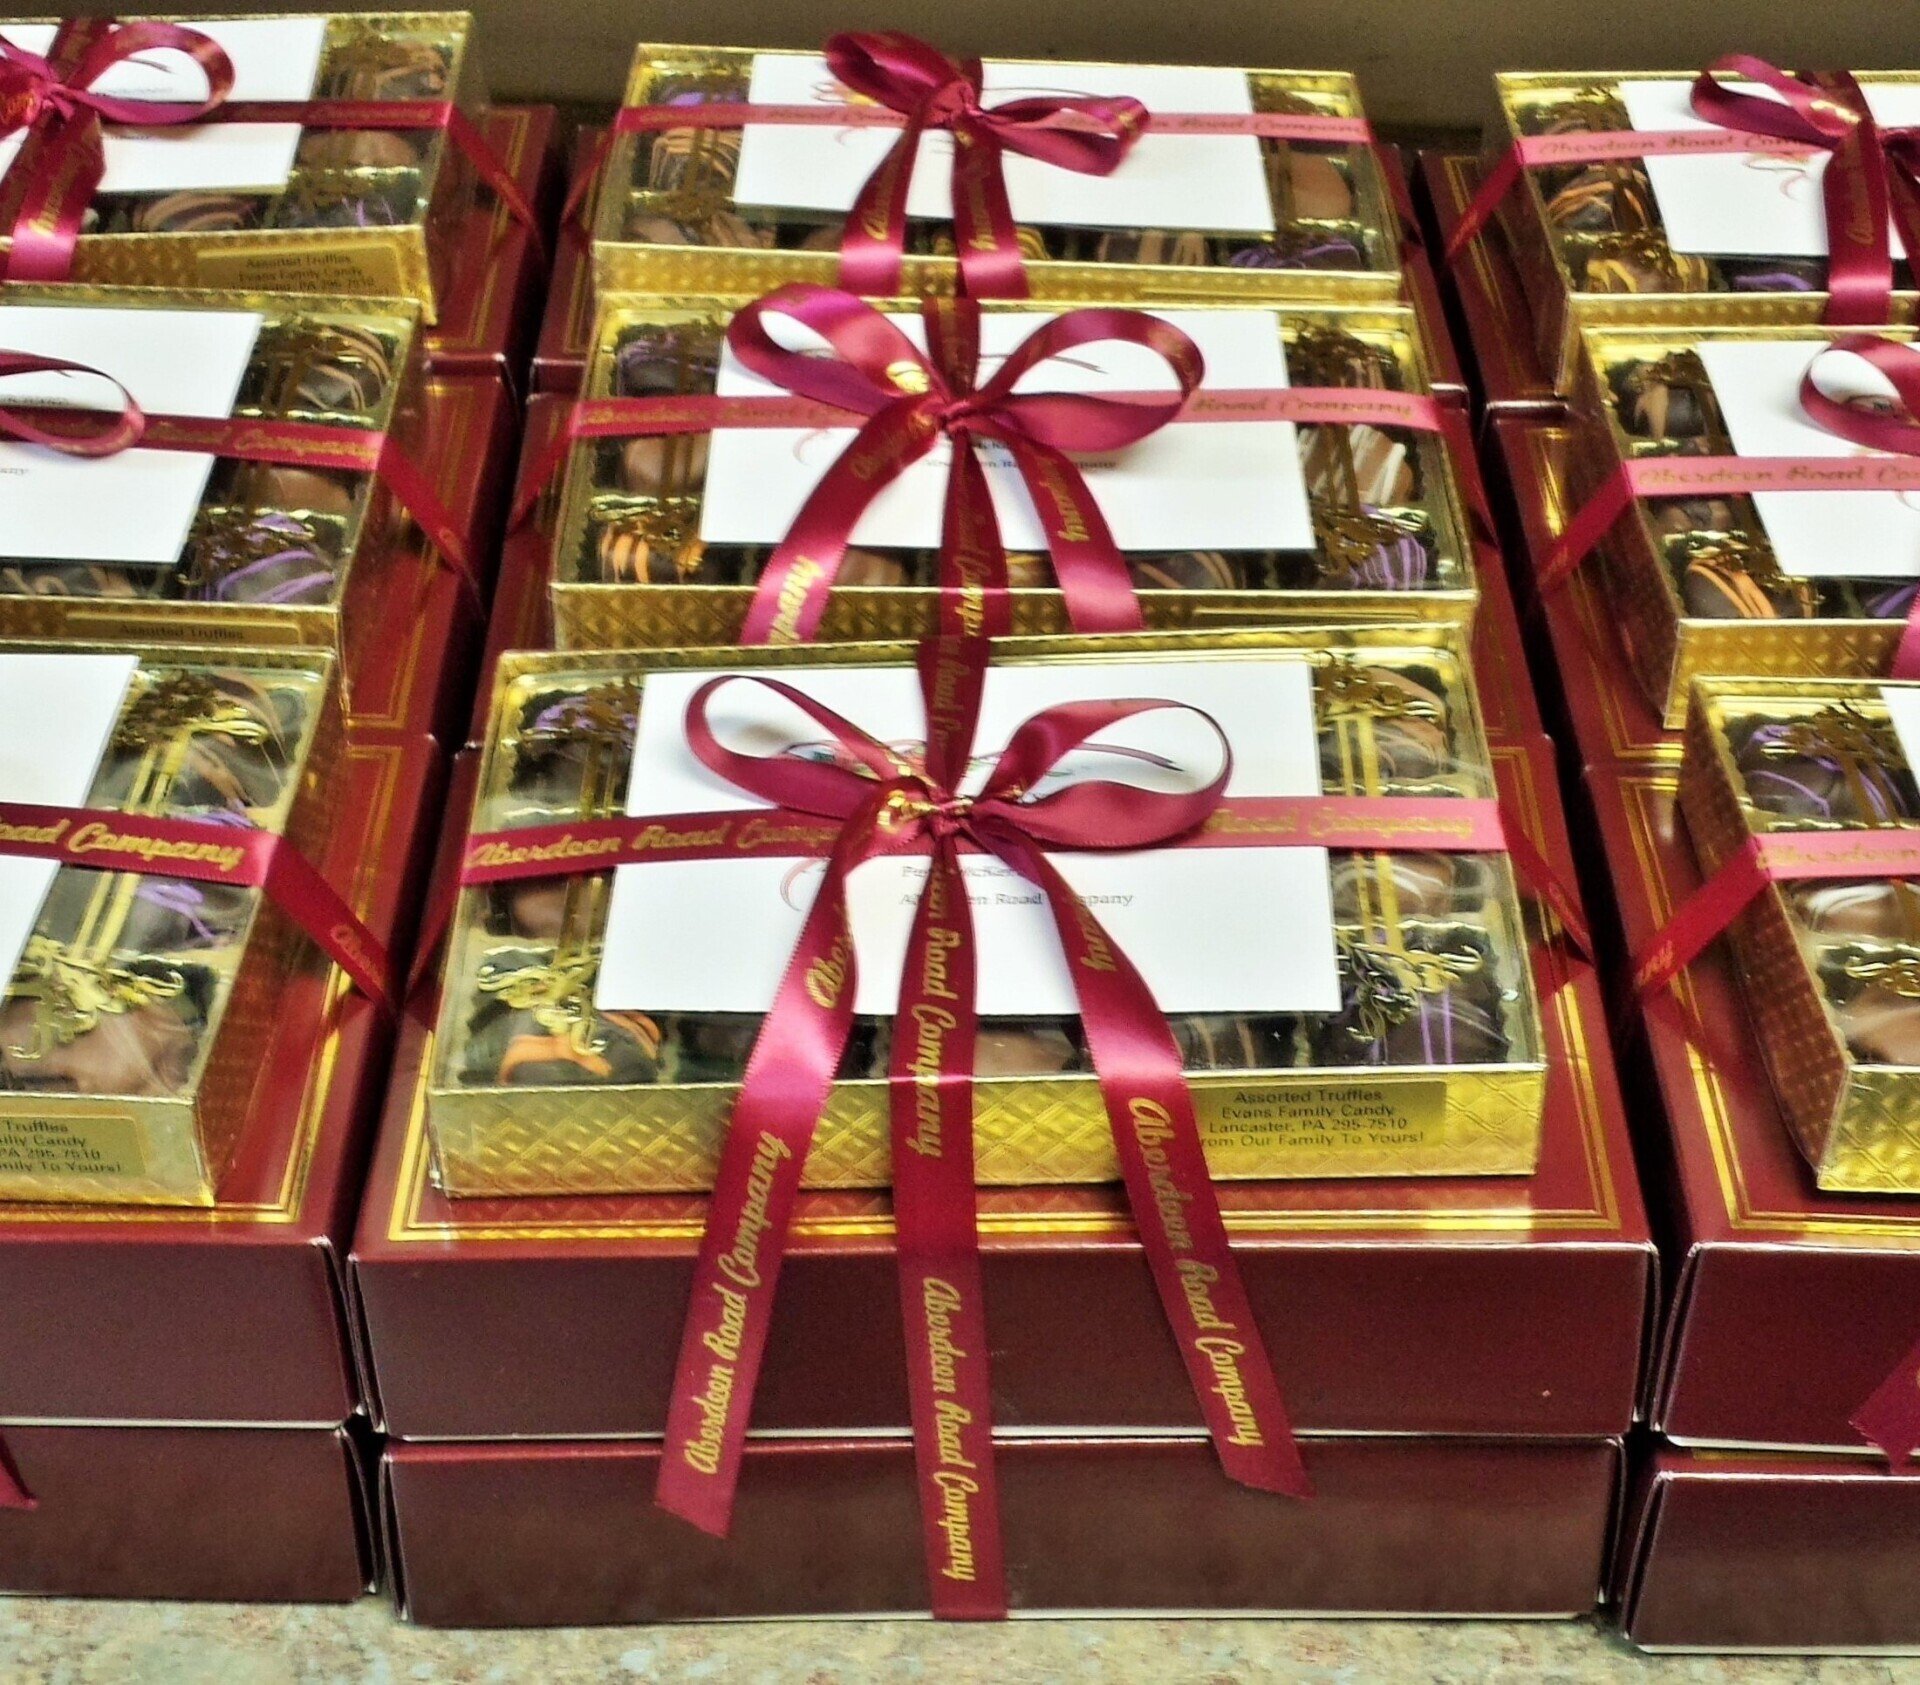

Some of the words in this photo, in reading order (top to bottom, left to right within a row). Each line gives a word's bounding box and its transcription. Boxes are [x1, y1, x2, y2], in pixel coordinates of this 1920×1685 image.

[67, 822, 245, 873] Company
[465, 833, 622, 869] Aberdeen
[631, 820, 733, 851] Road
[1307, 806, 1476, 839] Company
[911, 1003, 958, 1158] Company
[1222, 1106, 1273, 1119] Evans
[1279, 1105, 1335, 1118] Family
[1341, 1103, 1396, 1118] Candy
[1233, 1090, 1312, 1104] Assorted
[1319, 1088, 1383, 1101] Truffles
[33, 1134, 86, 1148] Candy
[1201, 1138, 1234, 1147] rom
[1240, 1134, 1273, 1147] Our
[1279, 1134, 1335, 1147] Family
[1342, 1132, 1363, 1145] To
[1369, 1131, 1424, 1144] Yours!
[1302, 1120, 1325, 1131] PA
[717, 1129, 793, 1288] Company
[1128, 1096, 1194, 1250] Aberdeen
[702, 1281, 748, 1362] Road
[1175, 1257, 1237, 1331] Road
[922, 1276, 968, 1394] Aberdeen
[683, 1363, 736, 1476] Aberdeen
[1194, 1336, 1265, 1447] Company
[934, 1399, 978, 1470] Road
[932, 1471, 981, 1583] Company
